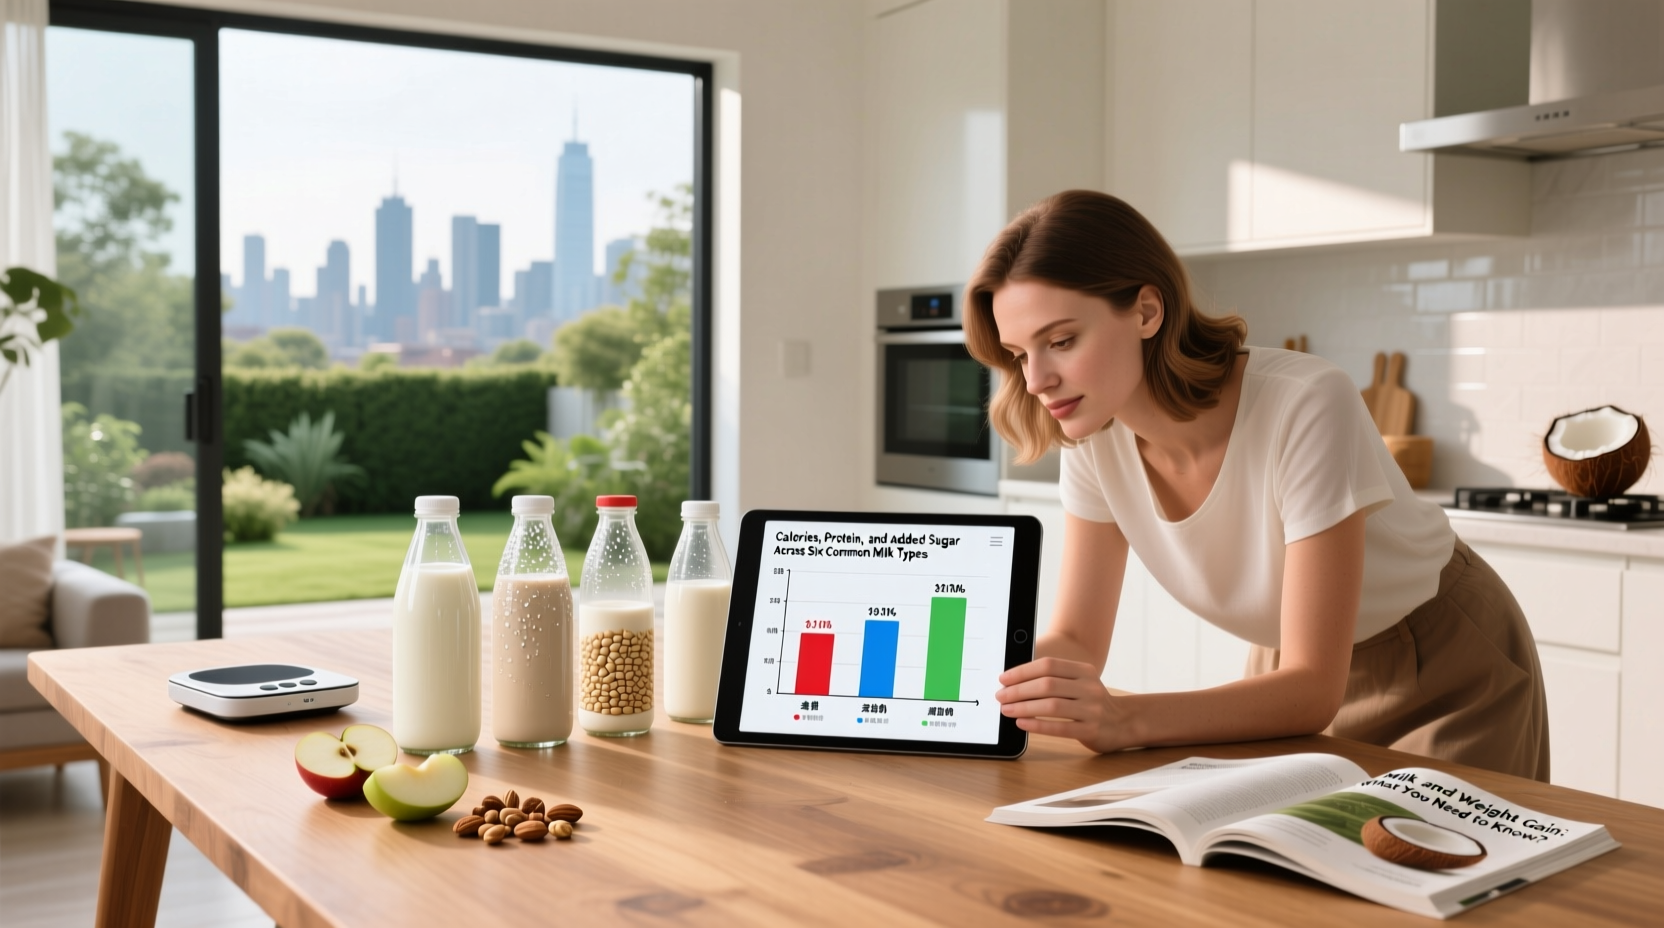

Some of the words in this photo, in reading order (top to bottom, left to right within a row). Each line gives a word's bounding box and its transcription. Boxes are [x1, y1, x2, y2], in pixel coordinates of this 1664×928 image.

[775, 530, 822, 545] Calories,
[824, 531, 864, 546] Protein,
[868, 532, 888, 545] and
[890, 532, 926, 545] Added
[928, 533, 961, 549] Sugar
[896, 546, 929, 562] Types
[1383, 772, 1418, 784] Milk
[1421, 781, 1458, 798] and
[1458, 792, 1520, 823] Weight
[1522, 819, 1569, 837] Gain:
[1401, 784, 1430, 802] You
[1431, 796, 1473, 819] Need
[1490, 821, 1549, 844] Know?
